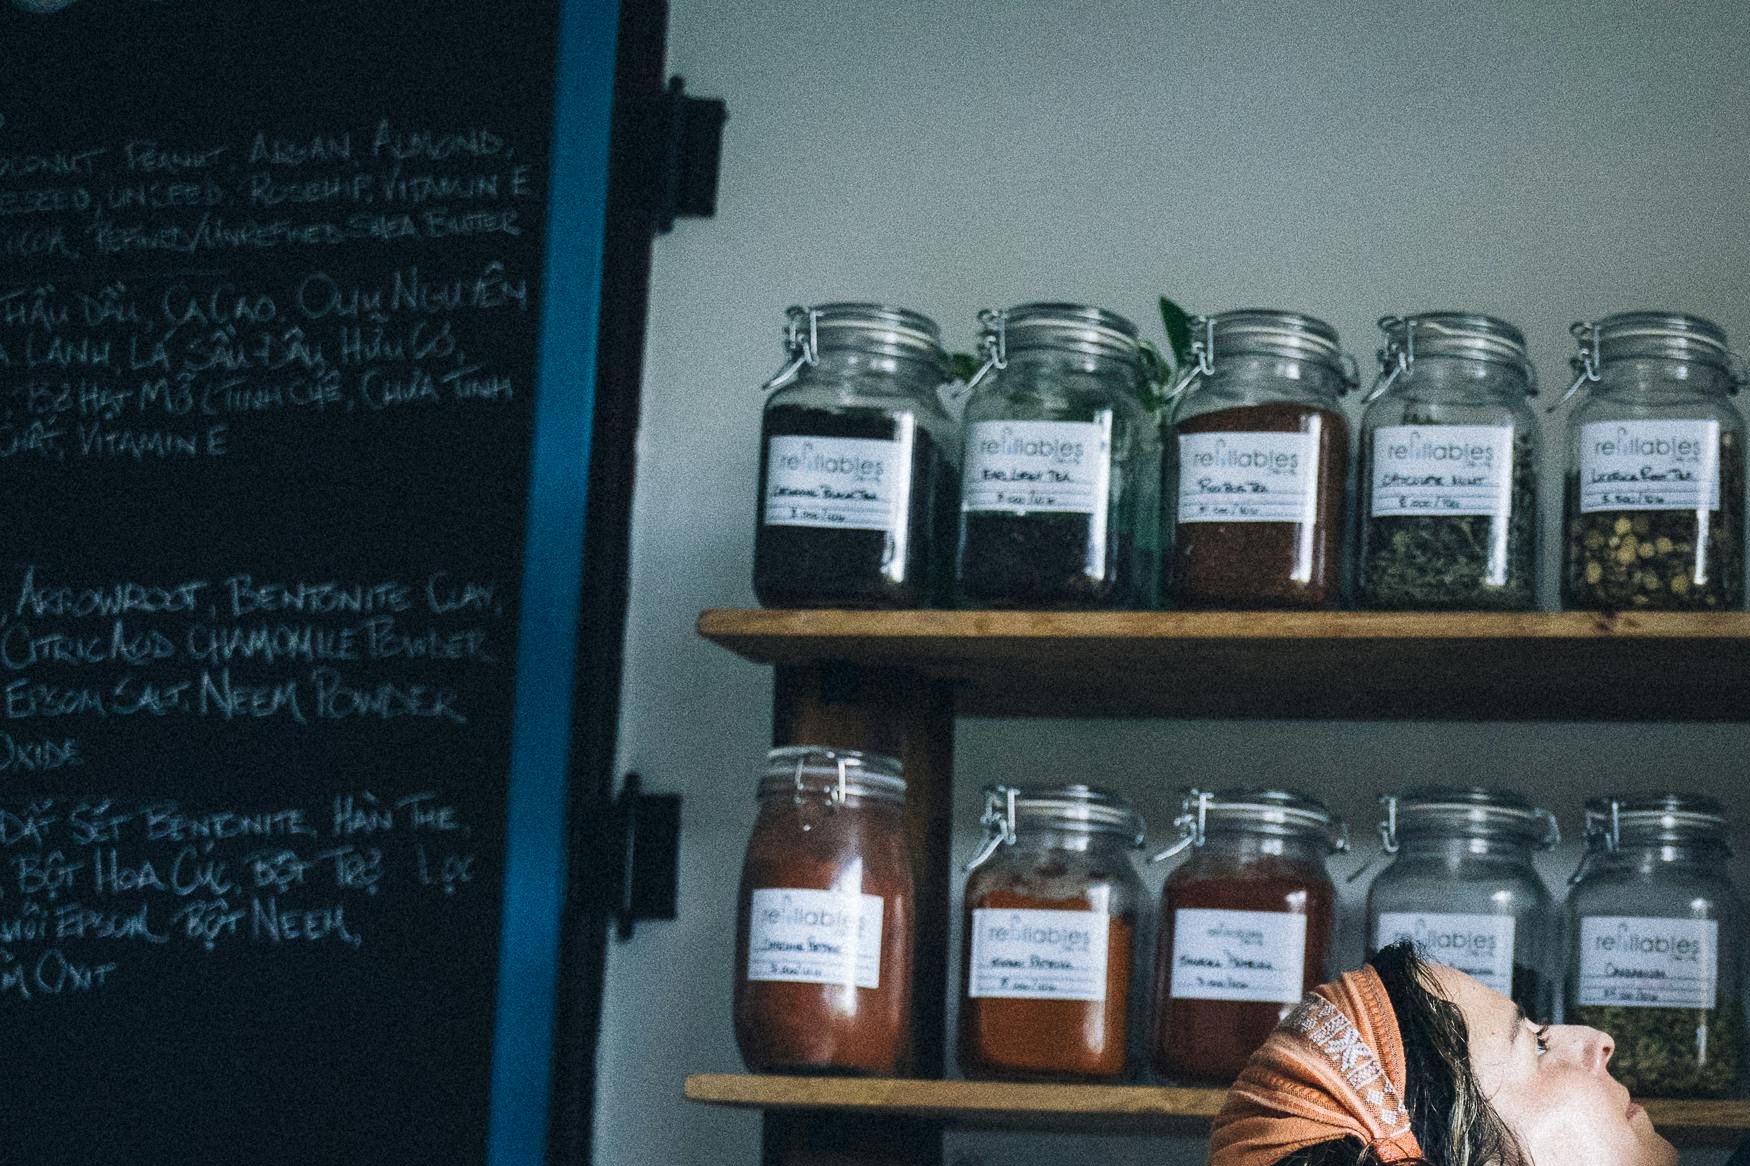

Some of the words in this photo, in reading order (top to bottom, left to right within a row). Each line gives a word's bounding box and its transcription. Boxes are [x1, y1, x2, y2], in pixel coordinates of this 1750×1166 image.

[511, 165, 531, 197] E
[206, 424, 228, 457] E
[981, 426, 1084, 460] refillables
[1194, 438, 1299, 470] refillables
[1387, 431, 1495, 461] refillables
[1595, 427, 1701, 458] refillables
[781, 441, 884, 477] refillables
[763, 894, 867, 928] refillabls
[1595, 921, 1701, 955] refillables
